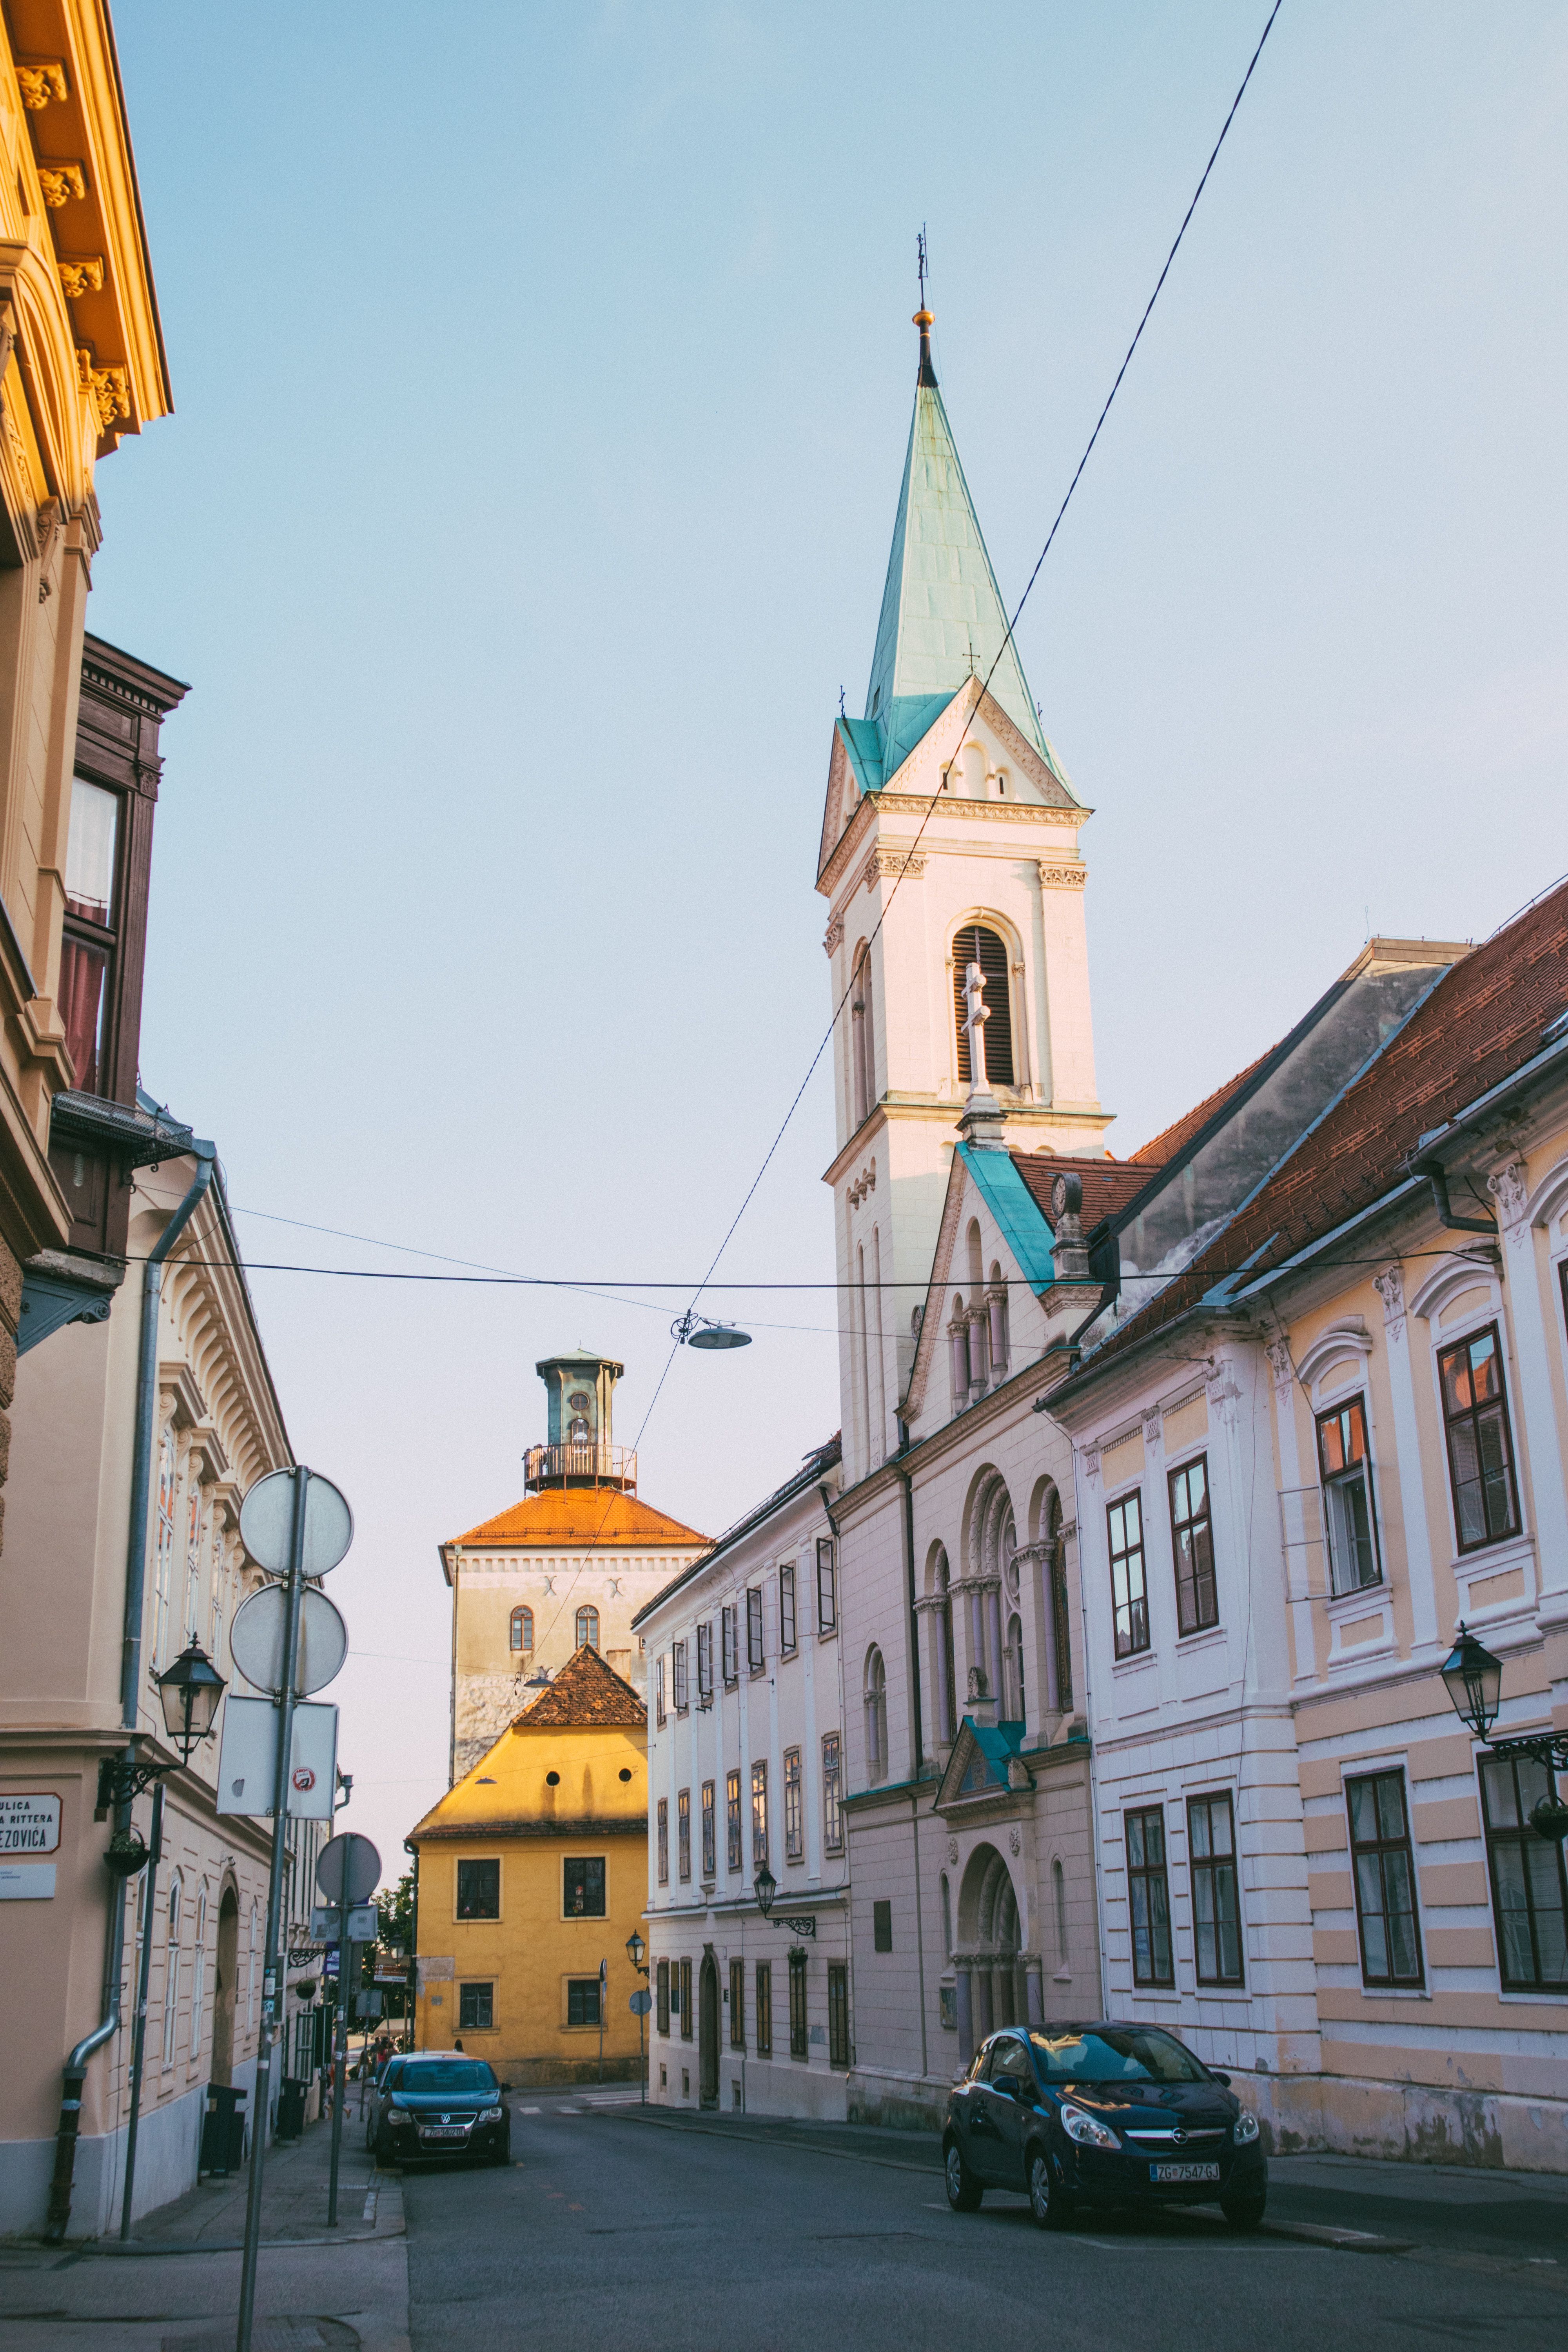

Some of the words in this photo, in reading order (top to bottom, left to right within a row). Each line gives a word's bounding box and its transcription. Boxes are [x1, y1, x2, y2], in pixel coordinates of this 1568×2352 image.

[0, 1801, 30, 1810] ULICA
[10, 1814, 52, 1824] RITTERA
[1158, 2167, 1171, 2179] ZG
